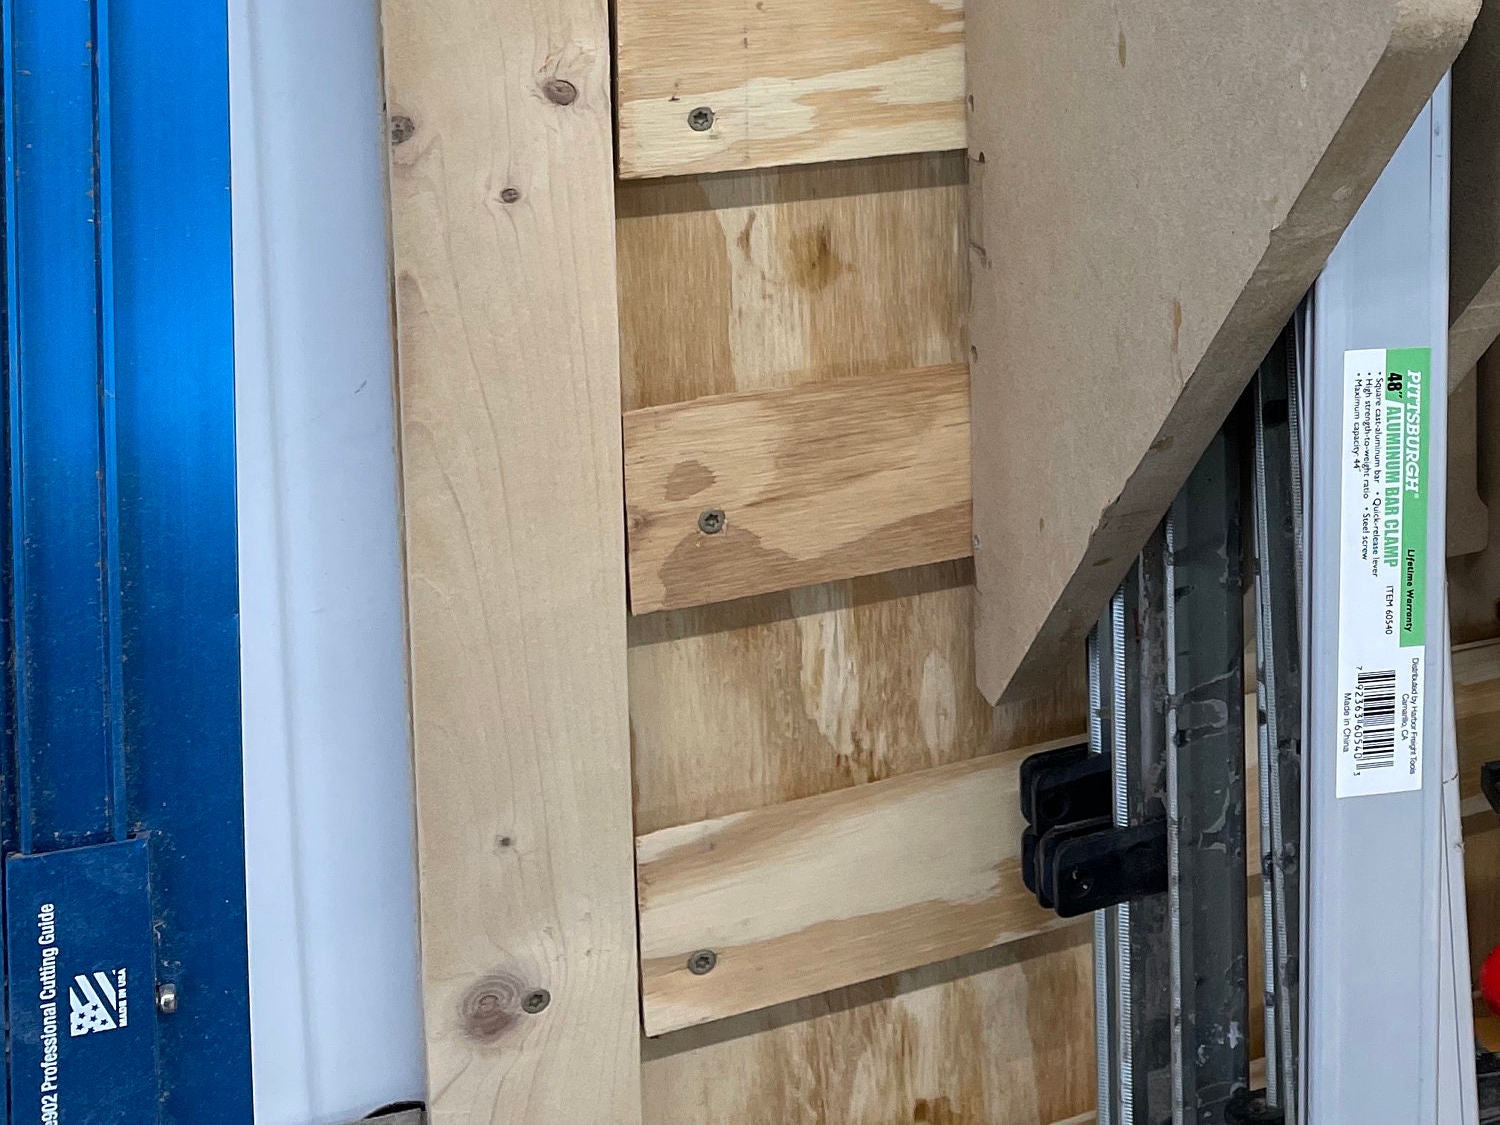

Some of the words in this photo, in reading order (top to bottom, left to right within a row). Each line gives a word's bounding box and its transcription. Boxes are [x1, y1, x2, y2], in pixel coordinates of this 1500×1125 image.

[1354, 379, 1363, 420] Maximum
[1363, 378, 1373, 397] High
[1373, 377, 1384, 406] Square
[1362, 400, 1372, 477] strength-to-weight
[1373, 409, 1383, 467] cast-aluminum
[1385, 406, 1401, 483] ALUMINUM
[1405, 370, 1421, 492] PITTSBURGH
[1362, 479, 1371, 499] ratio
[1373, 469, 1382, 483] bar
[1384, 487, 1399, 515] BAR
[1362, 513, 1371, 534] Steel
[1372, 497, 1382, 554] Quick-release
[1361, 536, 1370, 560] screw
[1383, 518, 1399, 568] CLAMP
[1371, 557, 1380, 577] lever
[1405, 549, 1415, 586] Lifetime
[1386, 585, 1394, 606] ITEM
[1385, 609, 1394, 635] 60540
[1404, 589, 1414, 632] Warranty
[1410, 657, 1420, 694] Distributed
[1343, 693, 1352, 716] Made
[1354, 684, 1364, 719] 92363
[1409, 696, 1419, 705] by
[1410, 706, 1418, 730] Harbor
[1343, 727, 1351, 753] China
[1354, 725, 1363, 759] 60540
[1401, 729, 1409, 741] CA
[1408, 732, 1418, 755] Freight
[1409, 756, 1418, 775] Tools
[37, 903, 55, 945] Guide
[39, 947, 59, 1000] Cutting
[117, 968, 127, 987] USA
[118, 988, 128, 999] IN
[118, 1000, 128, 1028] MADE
[40, 1004, 58, 1092] Professional
